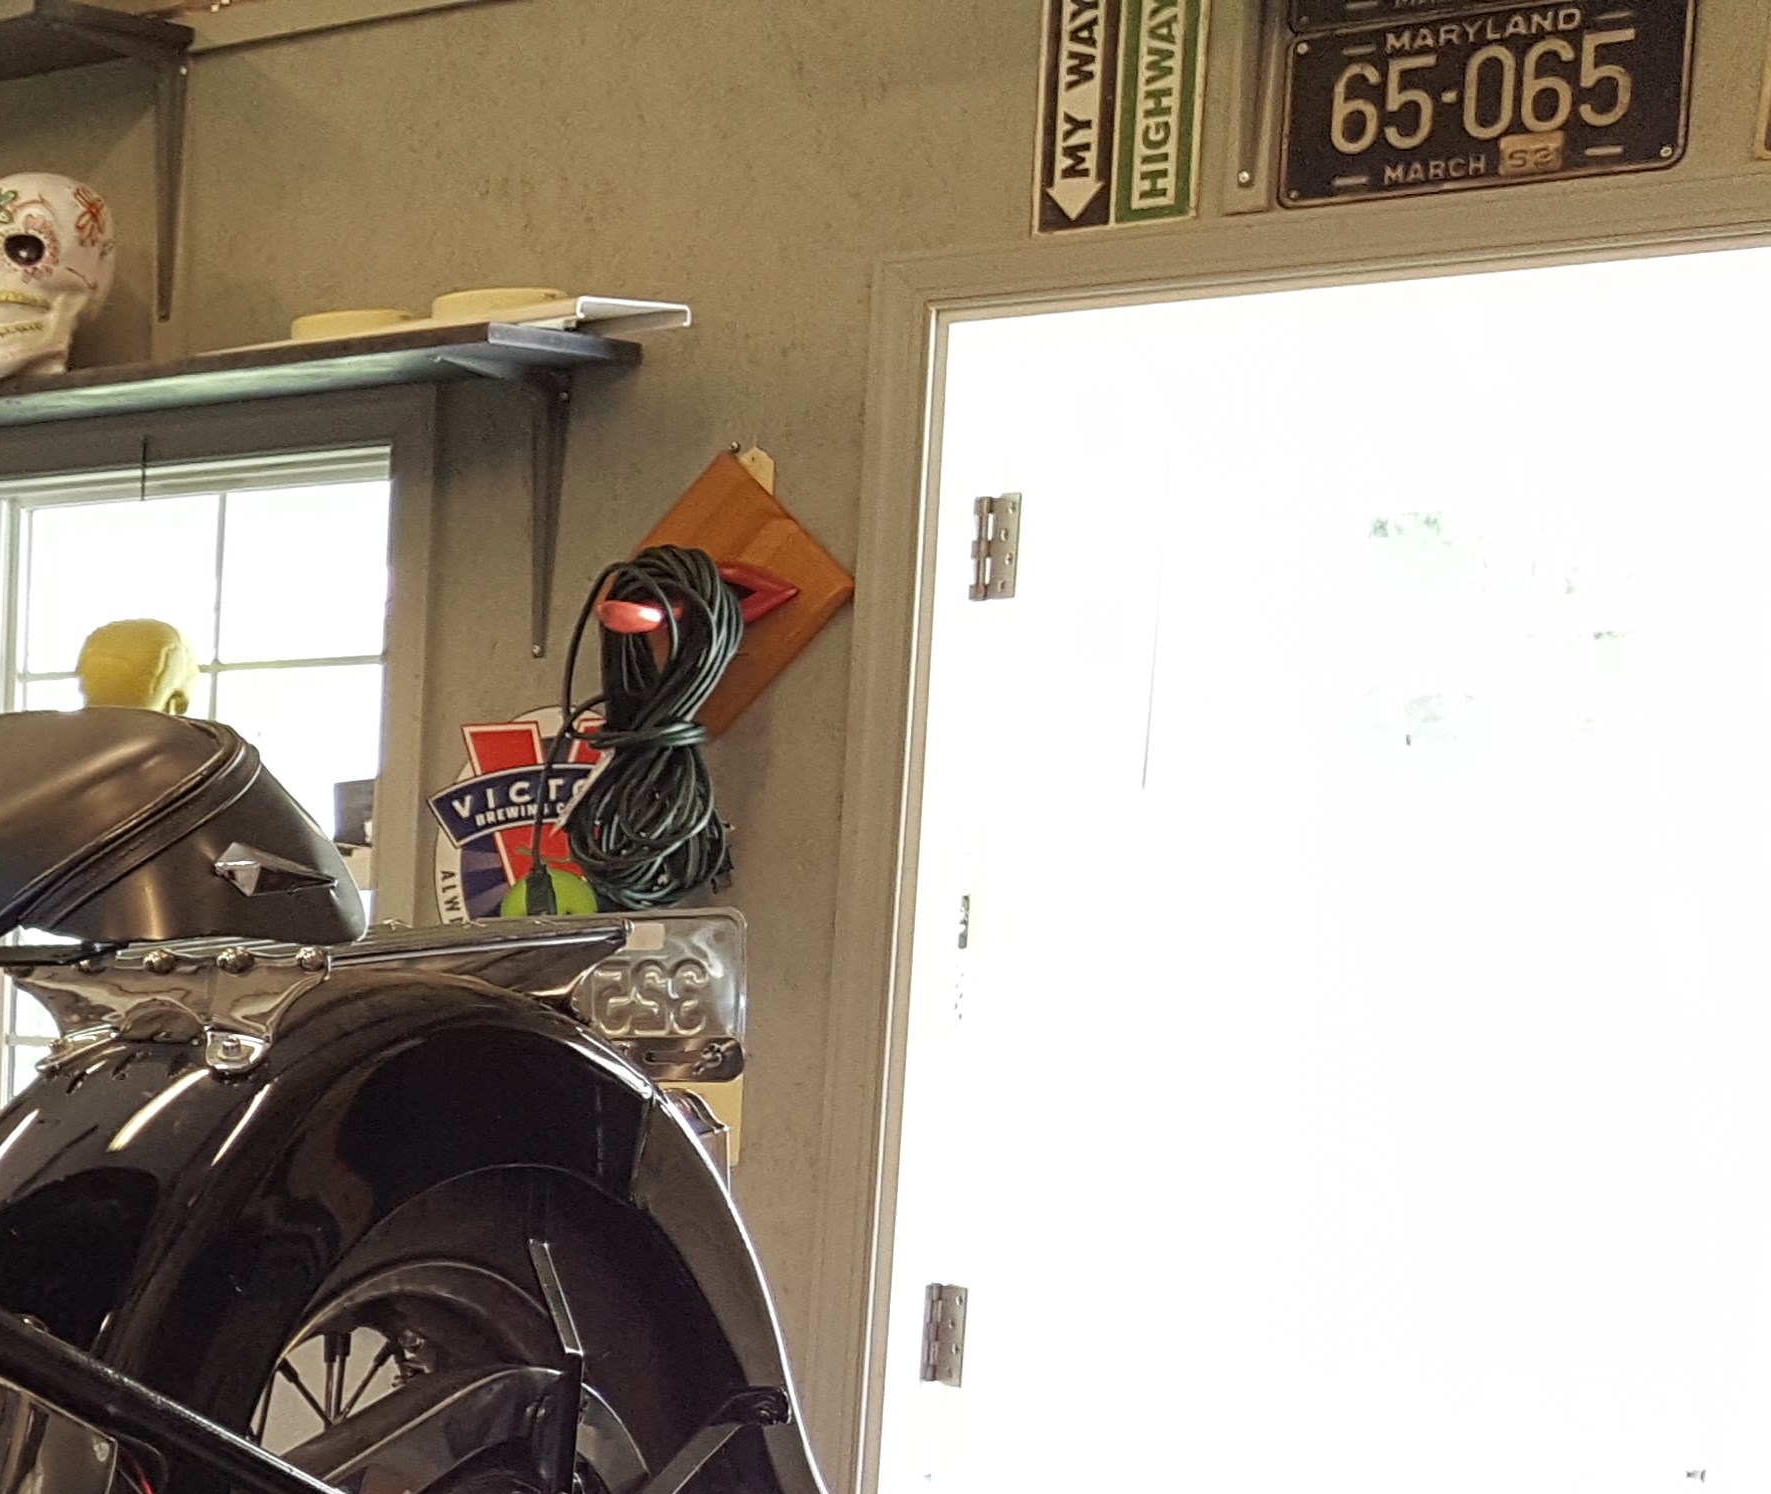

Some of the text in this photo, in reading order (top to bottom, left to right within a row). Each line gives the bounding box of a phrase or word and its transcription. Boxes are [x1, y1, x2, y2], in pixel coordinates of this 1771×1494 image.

[1384, 9, 1581, 54] MARYLAND
[1061, 0, 1099, 179] MY WAY
[1138, 0, 1179, 200] HIGHWAY
[1330, 28, 1636, 155] 65-065
[1384, 154, 1487, 186] MARCH
[451, 778, 586, 818] VICT
[475, 802, 548, 827] BREWIN
